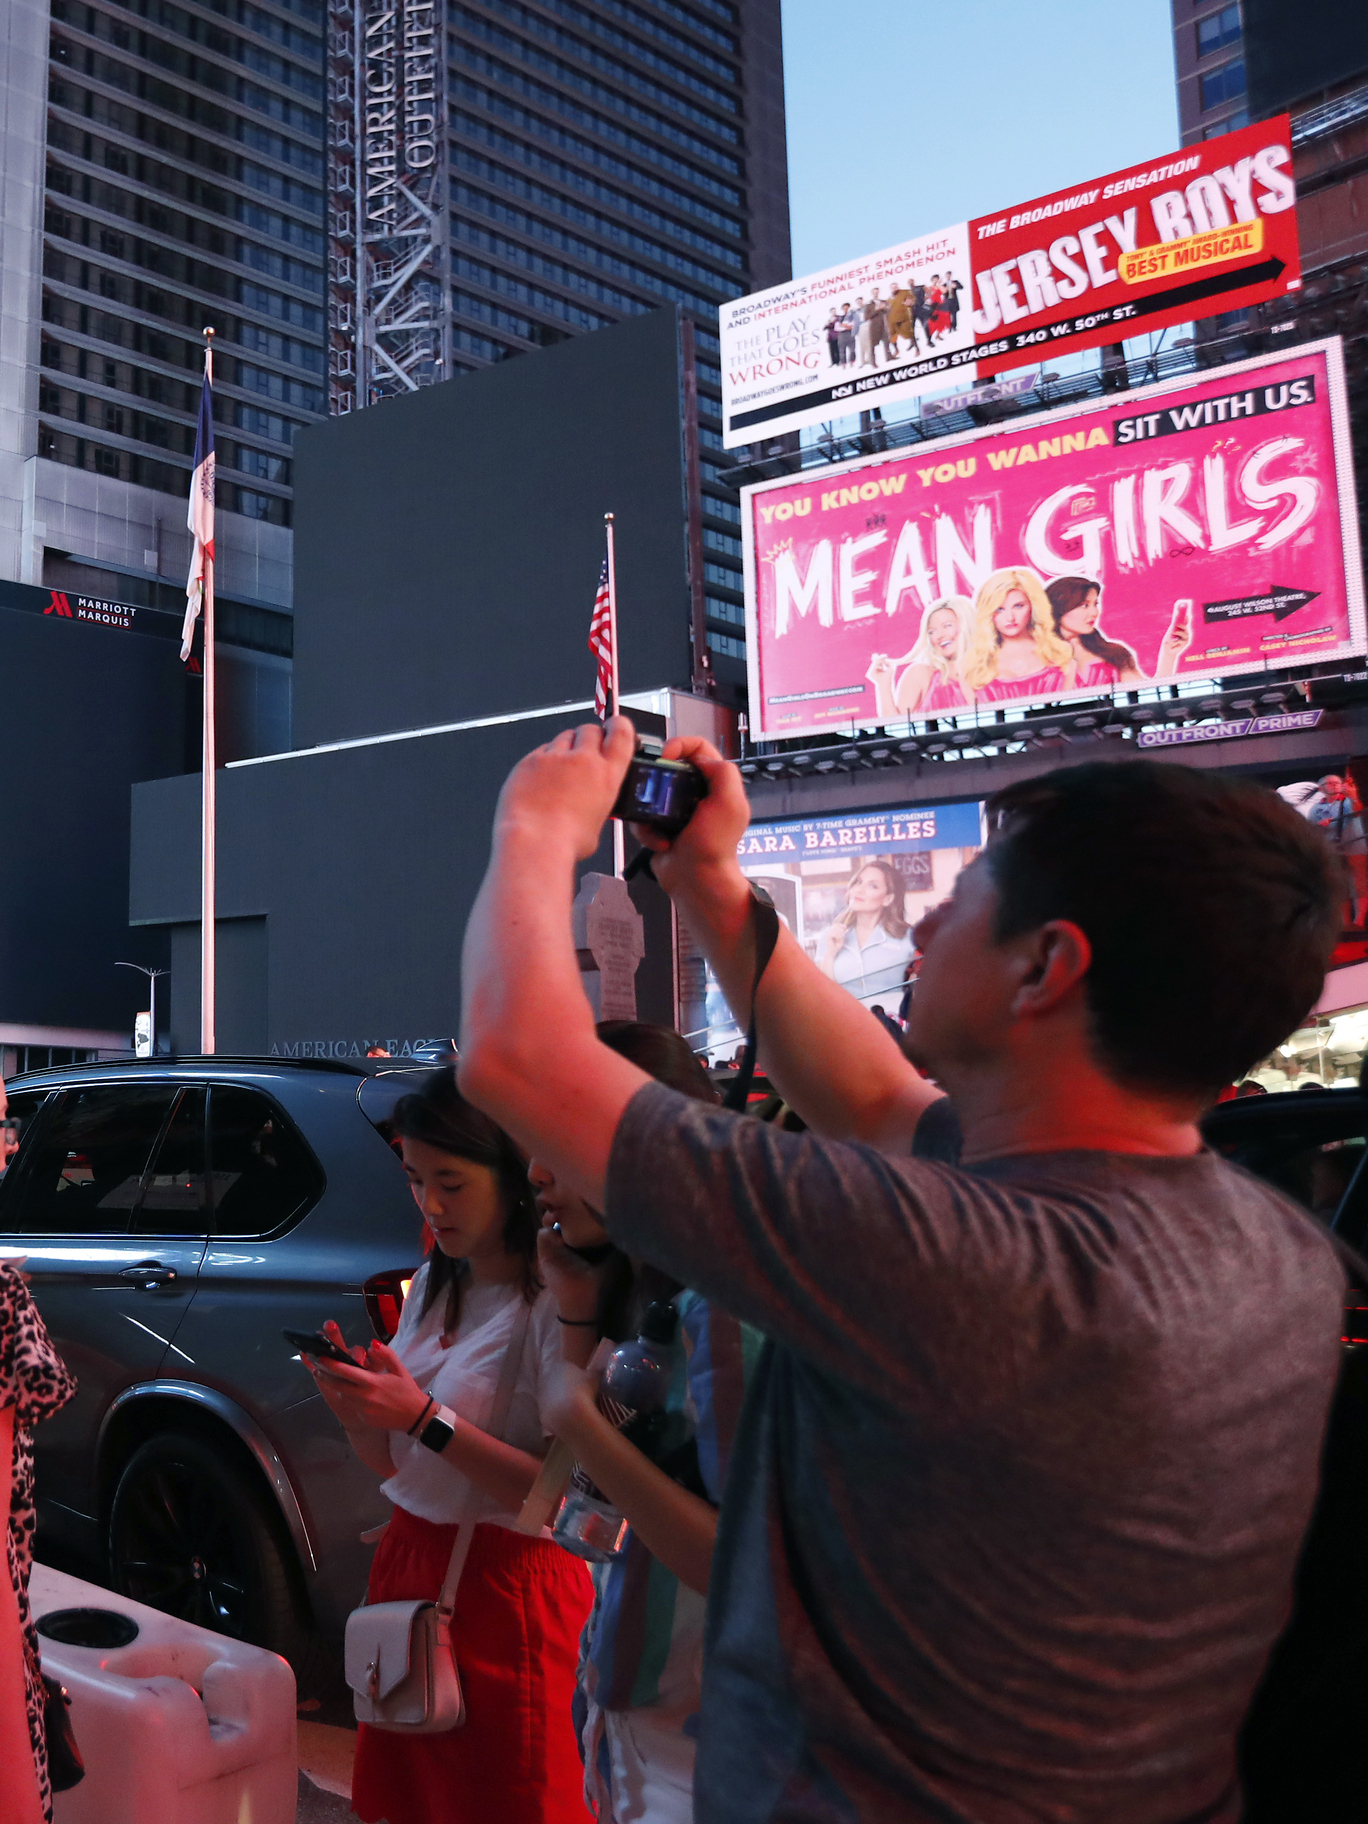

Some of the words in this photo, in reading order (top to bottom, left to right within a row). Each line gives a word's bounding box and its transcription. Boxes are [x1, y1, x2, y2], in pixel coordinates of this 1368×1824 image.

[365, 11, 396, 225] AMERICAN
[977, 218, 1007, 240] THE
[1009, 189, 1100, 231] BROADWAY
[1102, 155, 1202, 201] SENSATION
[969, 206, 1137, 334] JERSEY
[1150, 144, 1296, 244] BOYS
[1126, 254, 1168, 278] BEST
[1173, 233, 1254, 268] MUSICAL
[727, 314, 751, 330] AND
[754, 282, 854, 321] INTERNATIONAL
[859, 248, 957, 285] PHENOMENON
[731, 286, 807, 319] BROADWAY'S
[810, 265, 870, 291] FUNNIEST
[875, 250, 921, 270] SMASH
[926, 239, 949, 254] HIT
[729, 347, 763, 368] THAT
[767, 327, 821, 358] GOES
[736, 330, 761, 352] THE
[765, 315, 811, 343] PLAY
[856, 373, 890, 393] NEW
[894, 357, 948, 382] WORLD
[950, 341, 1009, 366] STAGES
[1016, 329, 1048, 348] 340
[1050, 323, 1072, 339] W.
[1075, 312, 1110, 332] 50TH
[1112, 304, 1137, 321] ST.
[729, 351, 821, 386] WRONG
[924, 378, 1026, 414] UTFNT
[760, 497, 812, 525] YOU
[820, 473, 908, 512] KNOW
[916, 456, 976, 489] YOU
[986, 426, 1110, 472] WANNA
[1117, 409, 1164, 444] SIT
[1169, 393, 1255, 432] WITH
[1270, 381, 1313, 411] US.
[771, 502, 994, 640] MEAN
[1022, 437, 1323, 579] GIRLS
[77, 609, 130, 627] MARQUIS
[78, 597, 136, 617] MARRIOTT
[1243, 598, 1273, 609] WILSON
[1259, 641, 1287, 651] CASEY
[1142, 721, 1246, 745] OUTFRONT
[1258, 713, 1315, 731] PRIME
[737, 835, 796, 855] SARA
[805, 821, 936, 849] BAREILLES
[775, 824, 801, 834] MUSIC
[803, 822, 813, 832] BY
[815, 819, 844, 830] 7-TIME
[892, 811, 935, 823] NOMINEE
